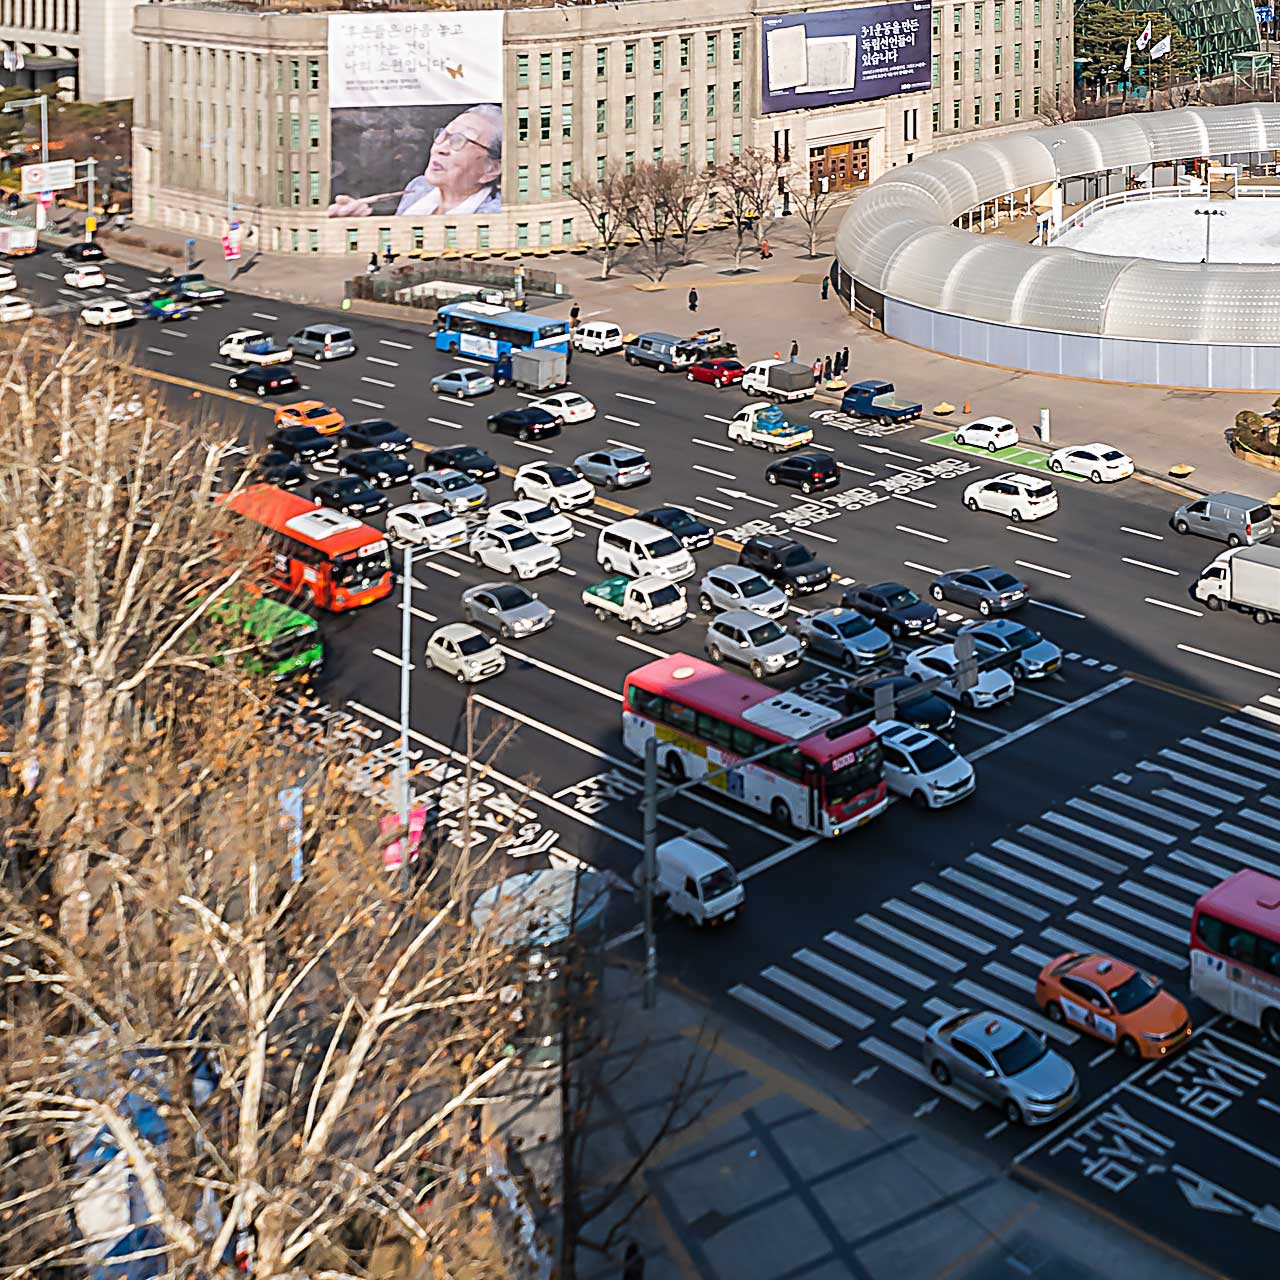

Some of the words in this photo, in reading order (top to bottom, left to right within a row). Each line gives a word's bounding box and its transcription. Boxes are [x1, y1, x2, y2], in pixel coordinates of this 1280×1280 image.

[901, 18, 920, 33] 만든
[861, 33, 915, 52] 독립선언들이
[861, 49, 899, 67] 있습니다
